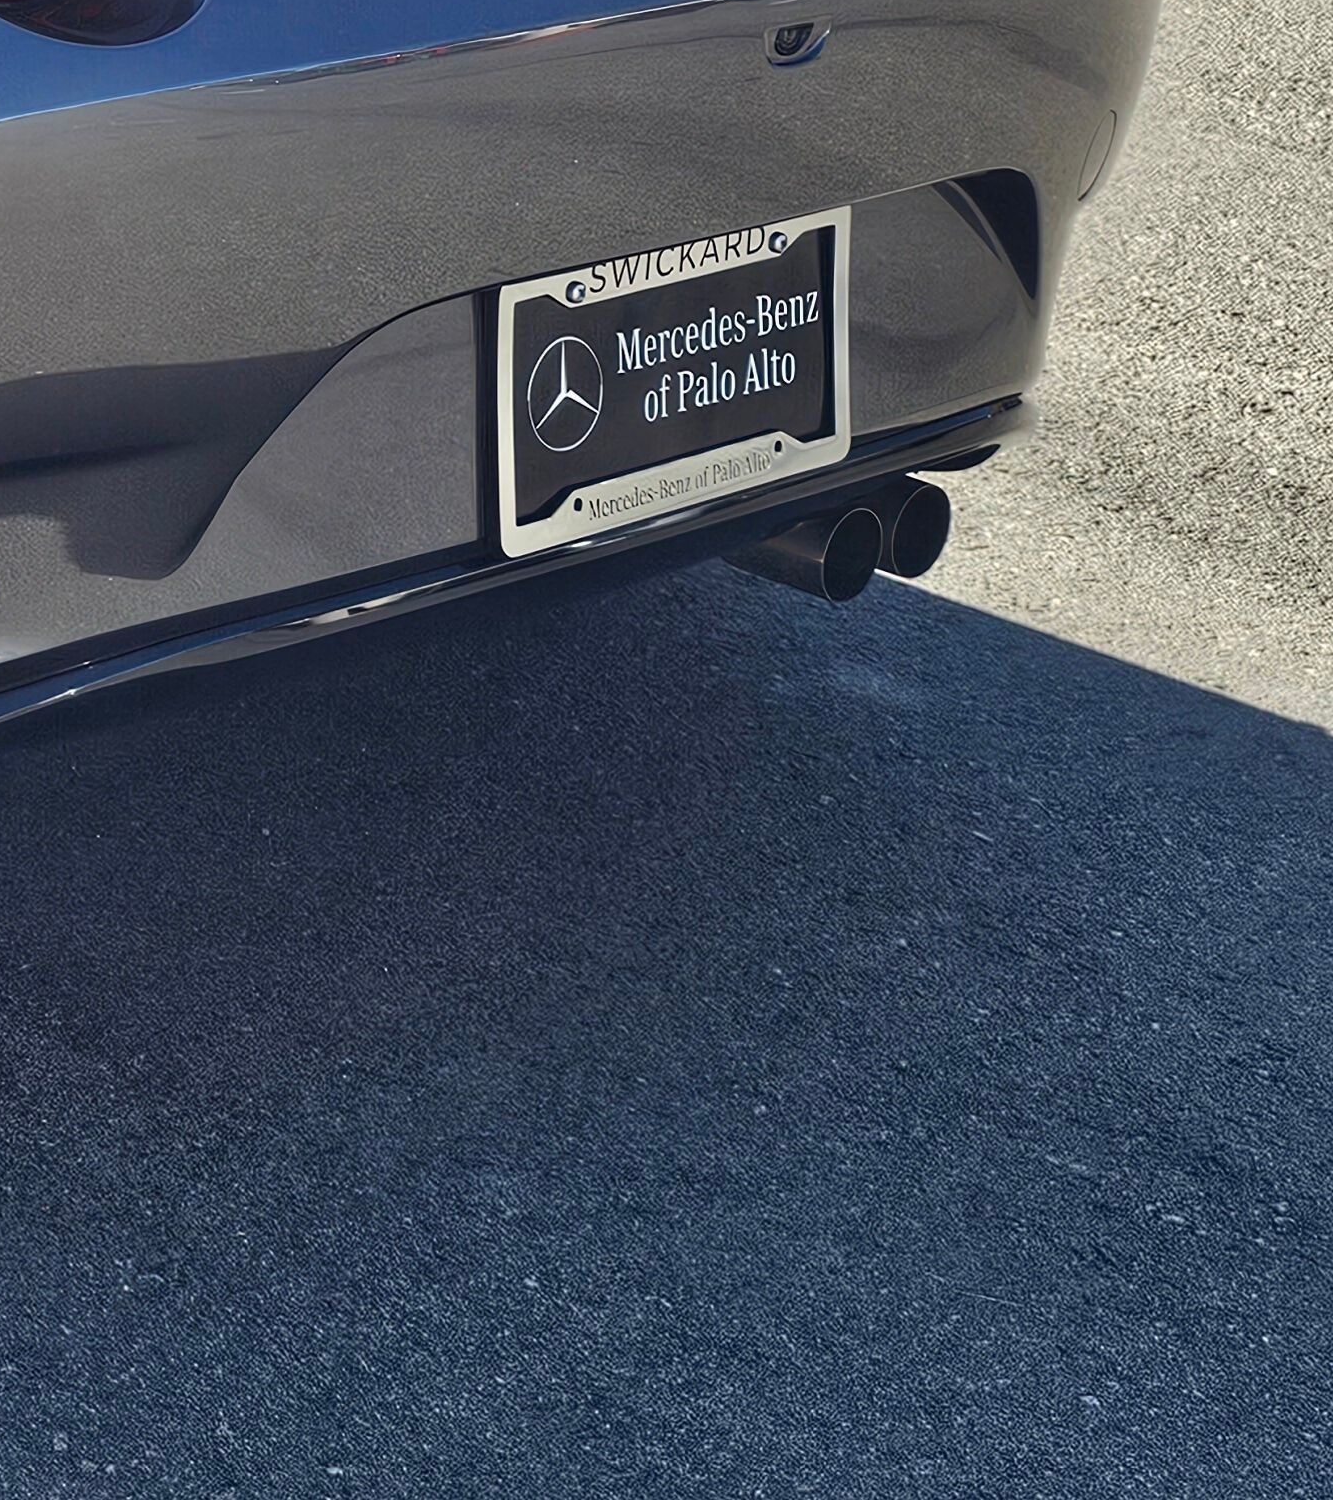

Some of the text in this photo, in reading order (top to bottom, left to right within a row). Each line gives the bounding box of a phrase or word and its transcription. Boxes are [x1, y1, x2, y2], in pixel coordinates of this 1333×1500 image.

[589, 226, 766, 293] SWICKARD
[616, 291, 819, 374] Mercedes-Benz
[644, 348, 796, 422] of Palo Alto
[589, 452, 771, 521] Mercedes-Benz of Palo Alto
